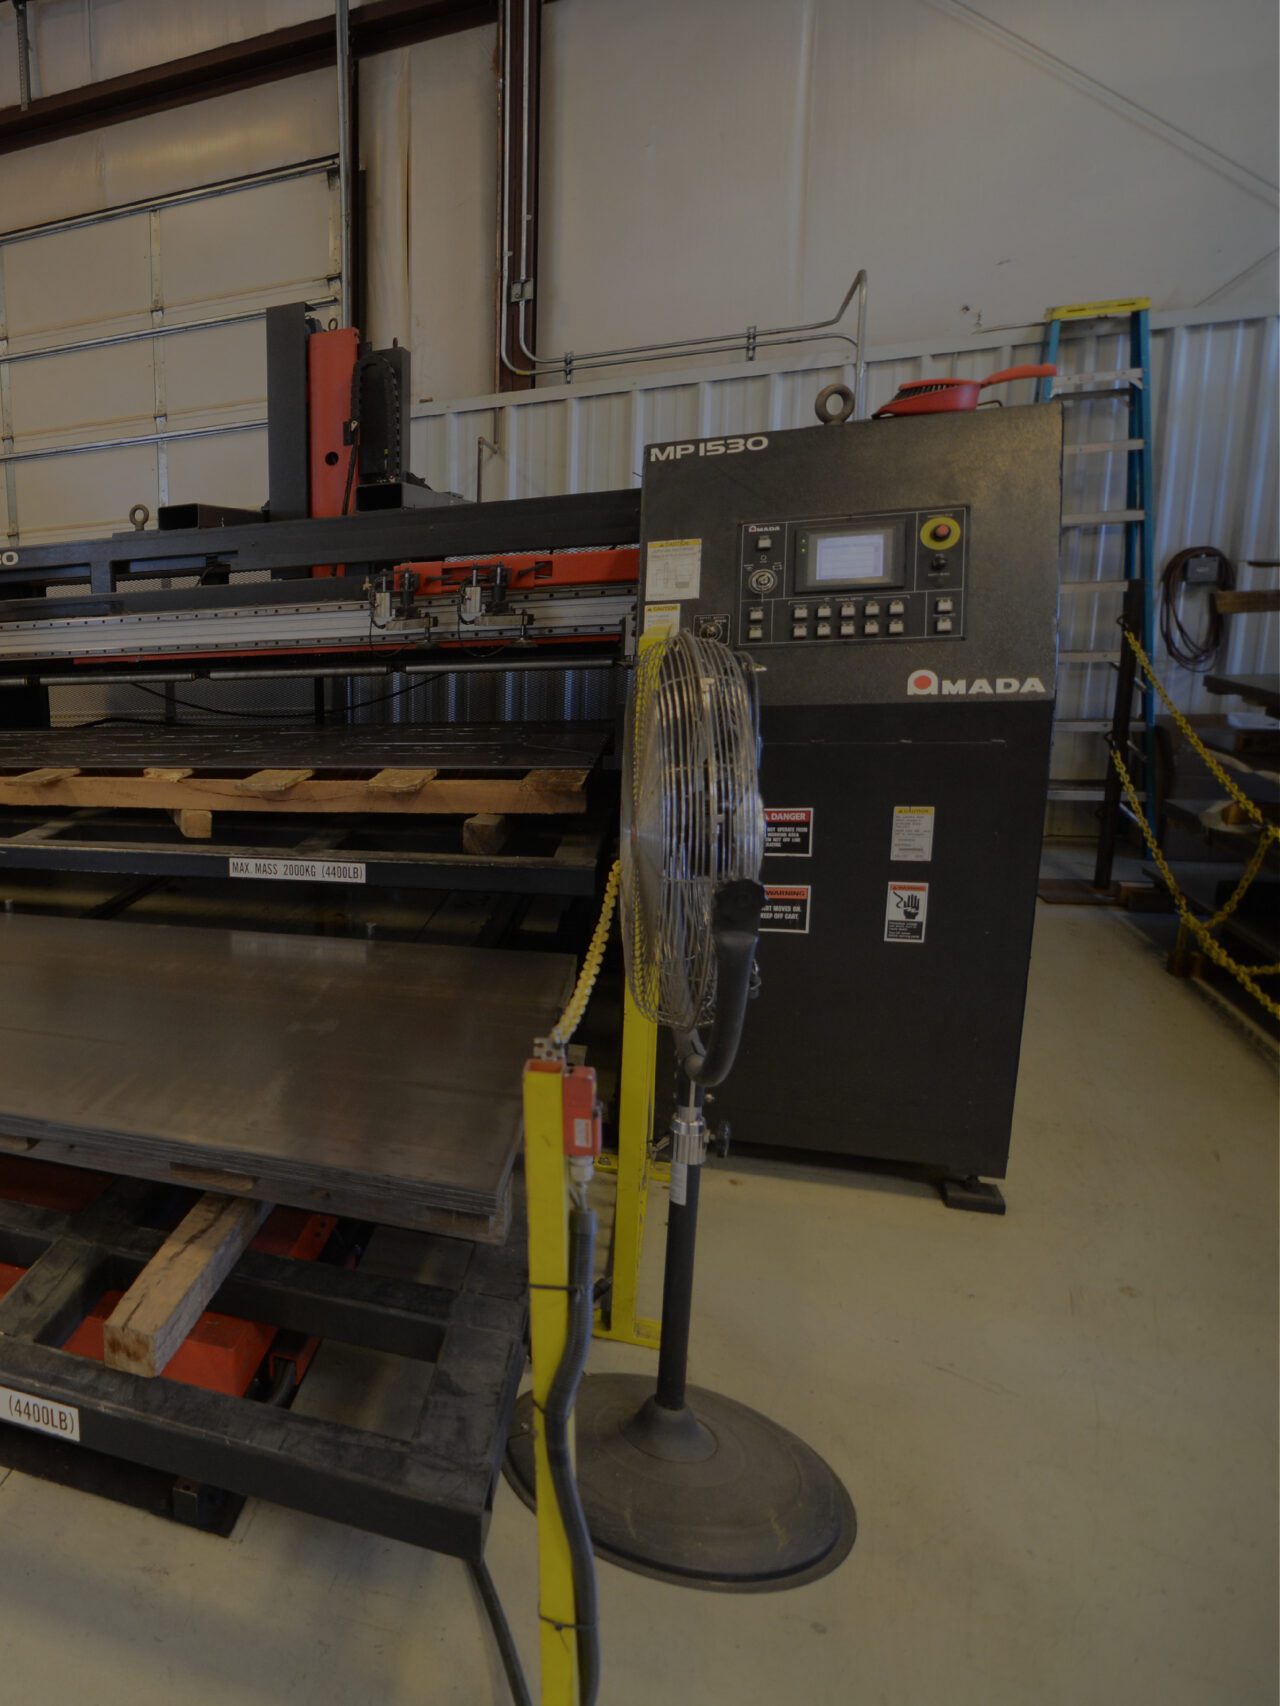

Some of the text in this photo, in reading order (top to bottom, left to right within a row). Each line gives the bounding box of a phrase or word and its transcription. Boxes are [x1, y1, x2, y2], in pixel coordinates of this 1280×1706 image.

[907, 669, 1046, 696] AMADA
[770, 812, 806, 821] DANGER
[255, 863, 278, 875] MASS
[283, 864, 316, 877] 2000KG
[322, 865, 363, 879] (4400LB)
[9, 1394, 75, 1434] (4400LB)
